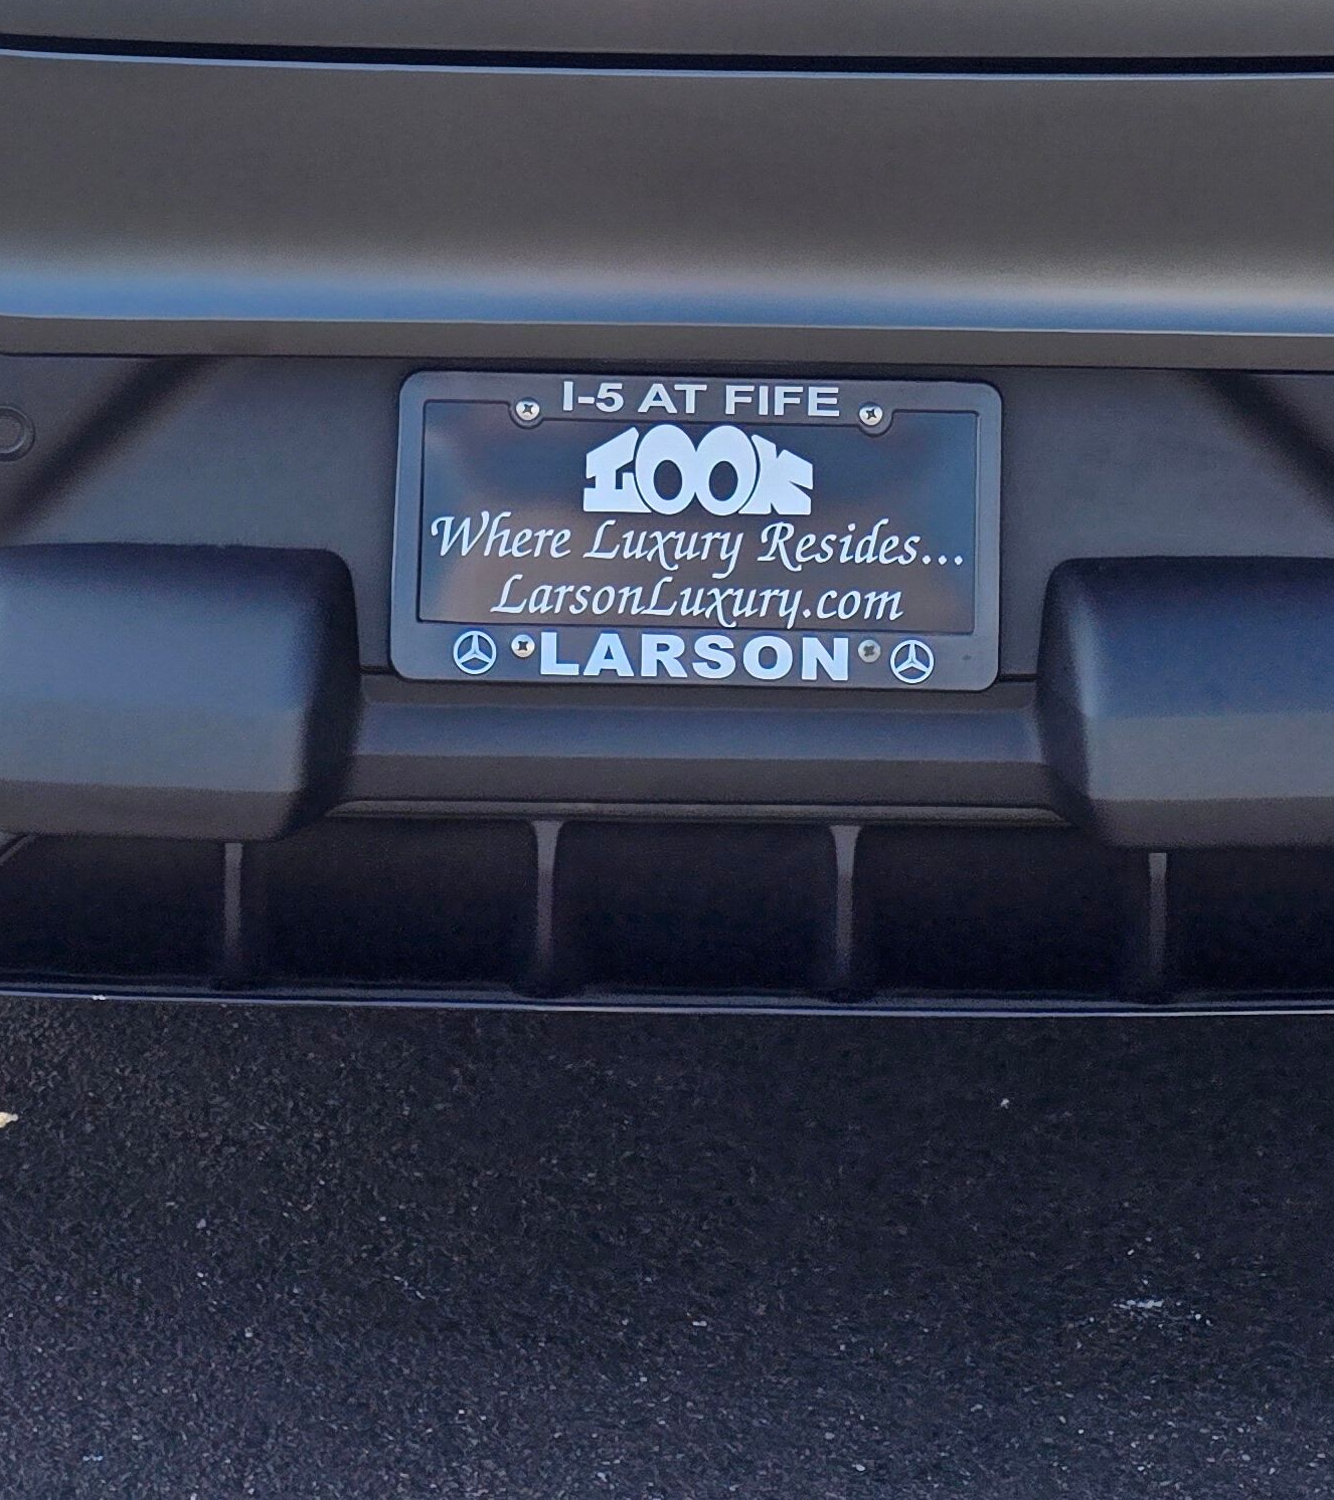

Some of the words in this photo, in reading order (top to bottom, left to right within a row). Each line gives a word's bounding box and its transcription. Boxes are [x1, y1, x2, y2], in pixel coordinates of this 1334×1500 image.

[562, 381, 624, 413] I-5
[638, 383, 707, 414] AT
[725, 385, 840, 416] FIFE
[431, 510, 571, 558] Where
[583, 519, 744, 579] Luxury
[758, 518, 964, 572] Resides...
[490, 573, 904, 629] LarsonLuxury.com
[540, 631, 849, 681] LARSON
